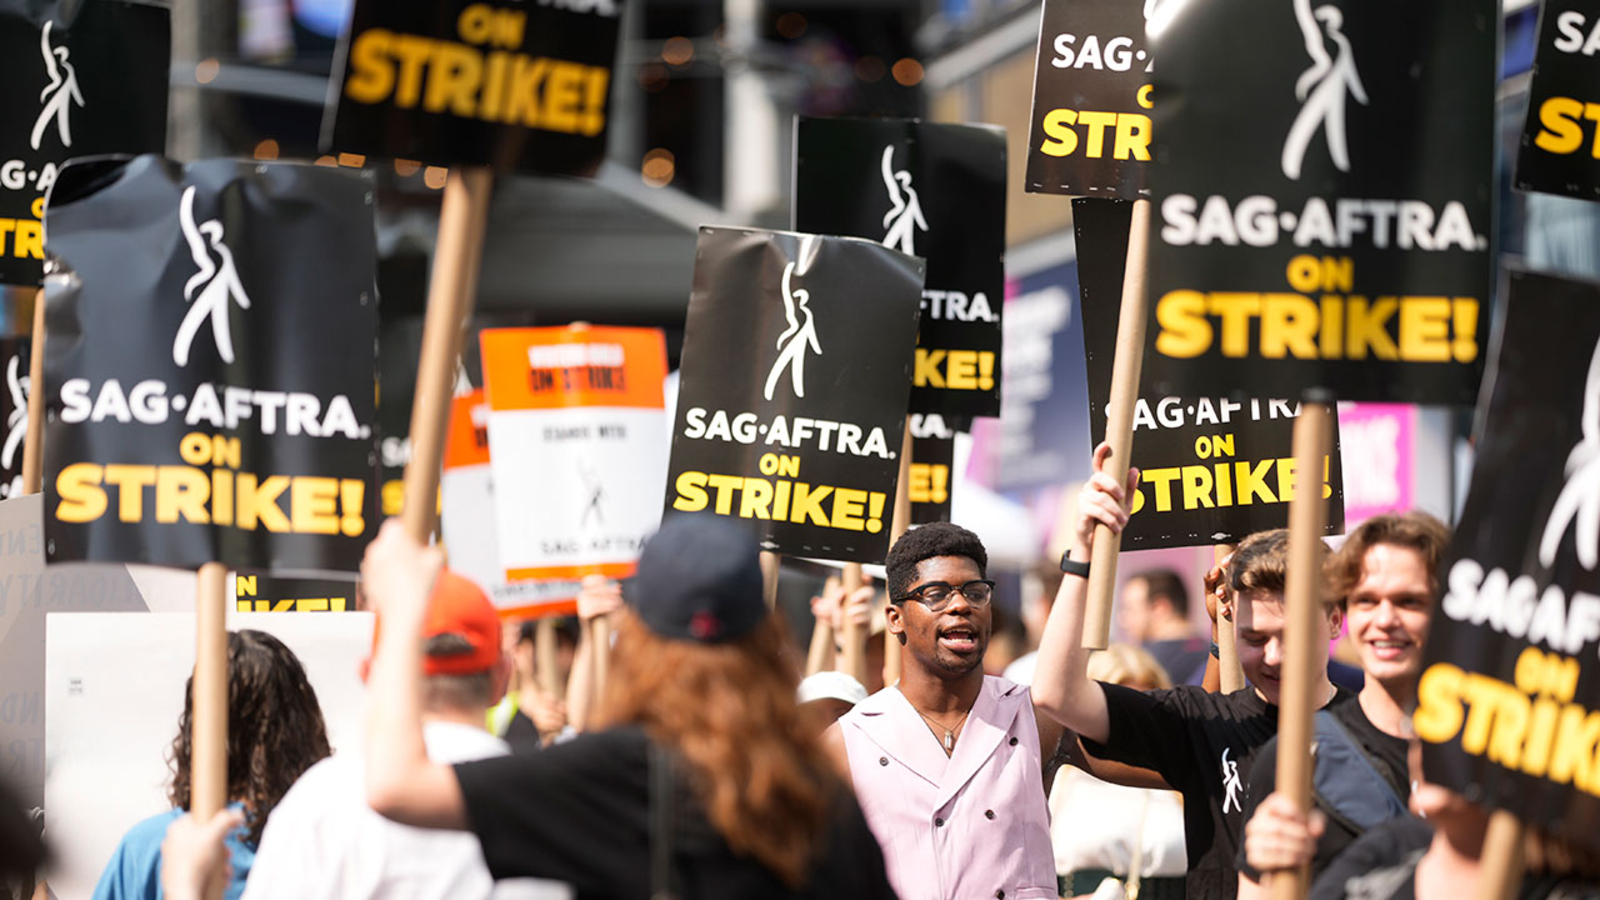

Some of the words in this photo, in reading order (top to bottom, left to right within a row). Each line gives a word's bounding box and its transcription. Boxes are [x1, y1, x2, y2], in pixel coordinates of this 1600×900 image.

[457, 3, 527, 49] ON
[1051, 33, 1154, 72] SAG·
[346, 29, 609, 136] STRIKE!
[1040, 108, 1153, 161] STR
[1161, 193, 1487, 250] SAG·AFTRA.
[1286, 255, 1354, 292] ON
[1155, 290, 1480, 363] STRIKE!
[60, 377, 371, 439] SAG·AFTRA.
[684, 407, 896, 460] SAG·AFTRA.
[179, 431, 242, 469] ON
[759, 453, 800, 478] ON
[1194, 433, 1236, 459] ON
[55, 462, 366, 537] STRIKE!
[673, 471, 887, 534] STRIKE!
